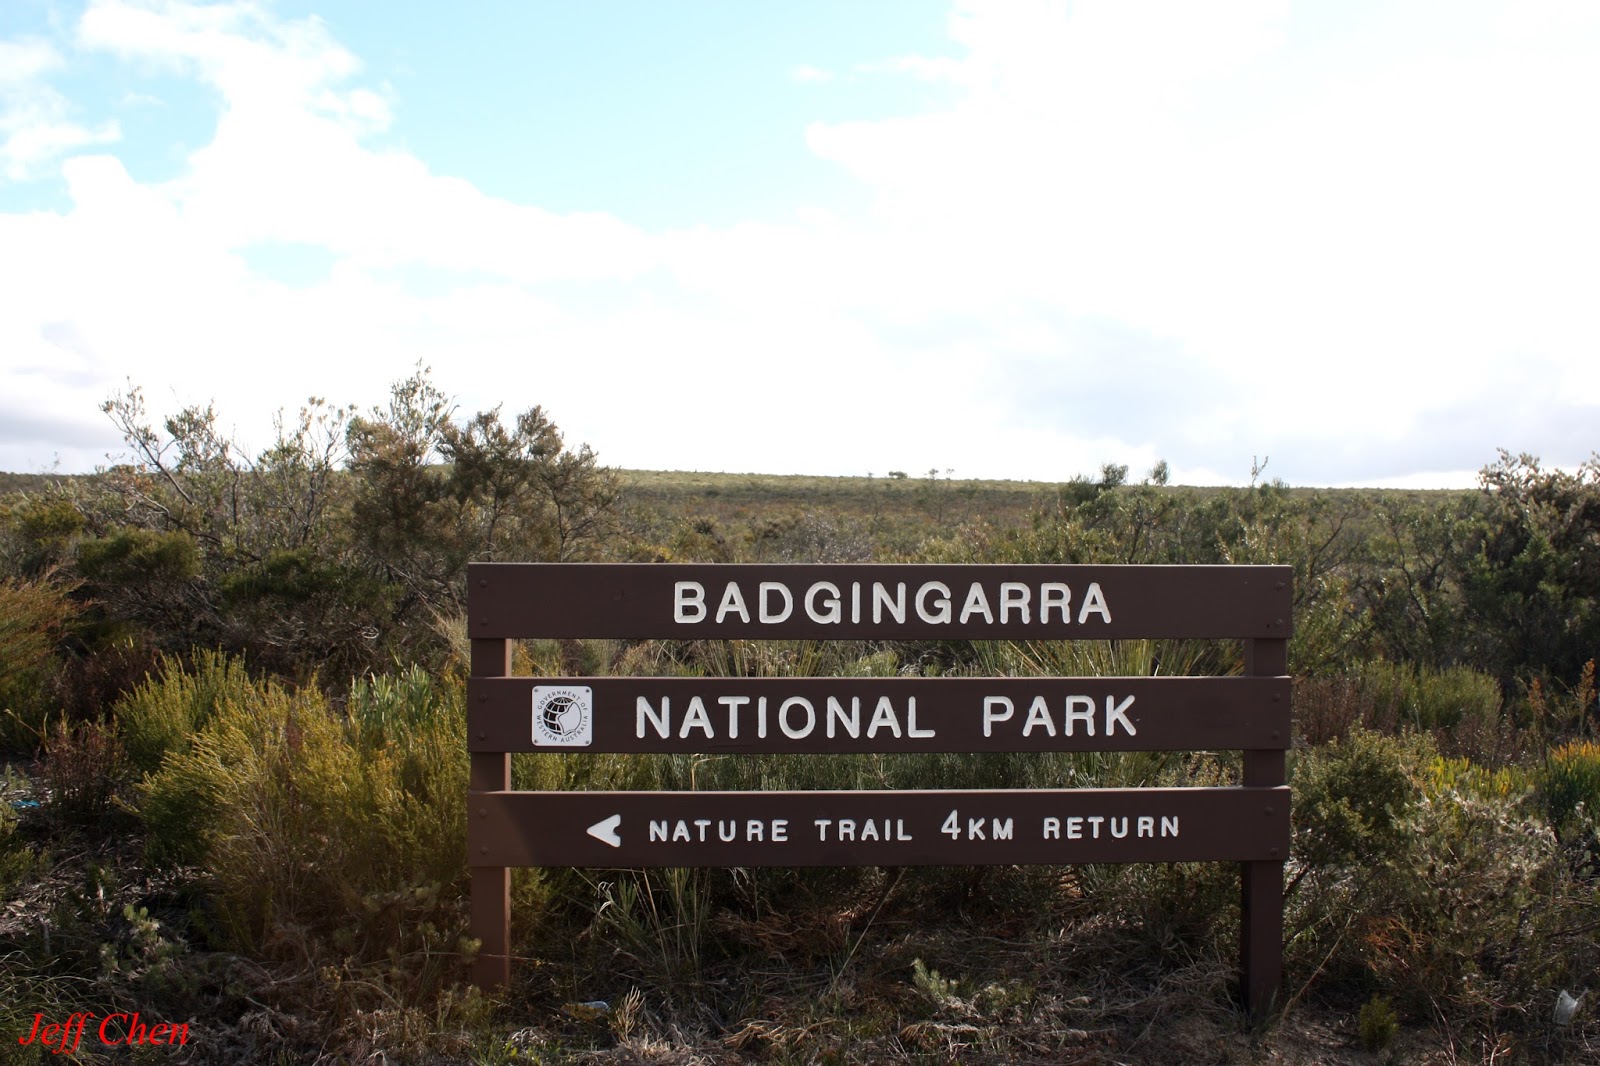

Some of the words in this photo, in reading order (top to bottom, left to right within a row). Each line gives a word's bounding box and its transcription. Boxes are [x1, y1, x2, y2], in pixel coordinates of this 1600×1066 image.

[673, 581, 1112, 625] BADGINGARRA
[537, 690, 581, 710] GOVERNMENT
[581, 702, 588, 710] OF
[635, 695, 936, 740] NATIONAL
[983, 694, 1138, 738] PARK
[536, 714, 558, 742] WESTERN
[560, 715, 588, 742] AUSTRALIA
[649, 819, 789, 843] NATURE
[814, 818, 913, 842] TRAIL
[940, 809, 1014, 841] 4KM
[1043, 815, 1180, 840] RETURN
